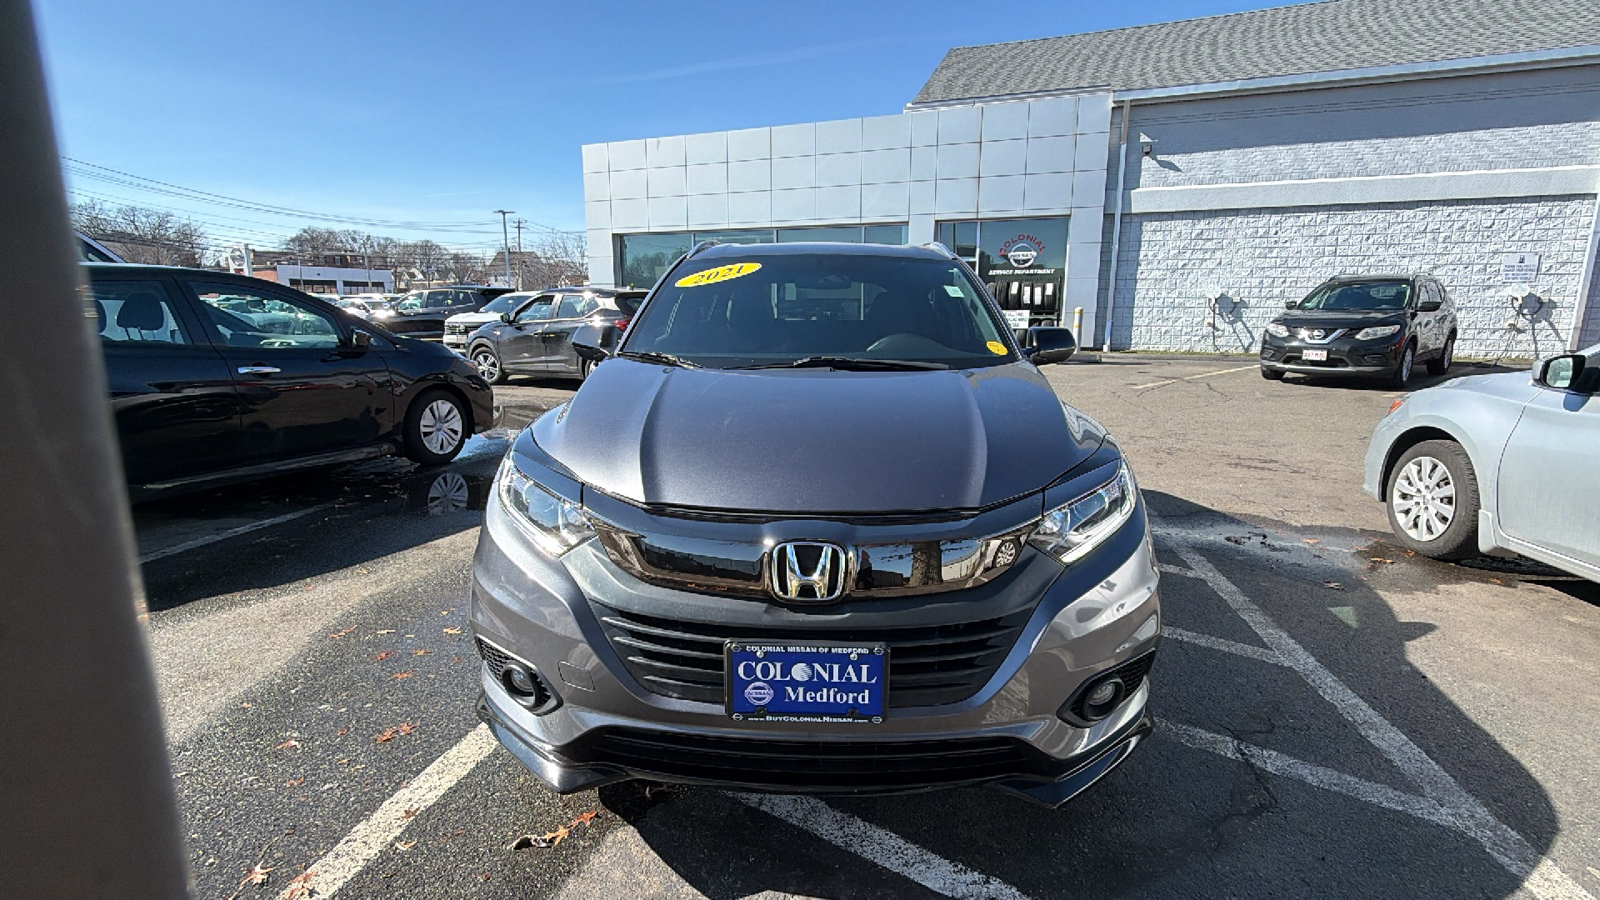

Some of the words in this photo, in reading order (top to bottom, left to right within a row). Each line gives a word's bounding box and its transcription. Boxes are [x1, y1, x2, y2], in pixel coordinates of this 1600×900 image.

[999, 234, 1046, 256] COLONIAL
[693, 265, 744, 284] 2021
[746, 645, 786, 653] COLONIAL
[831, 647, 869, 655] MEDFORD
[737, 661, 877, 684] COLONIAL
[784, 686, 870, 704] Medford
